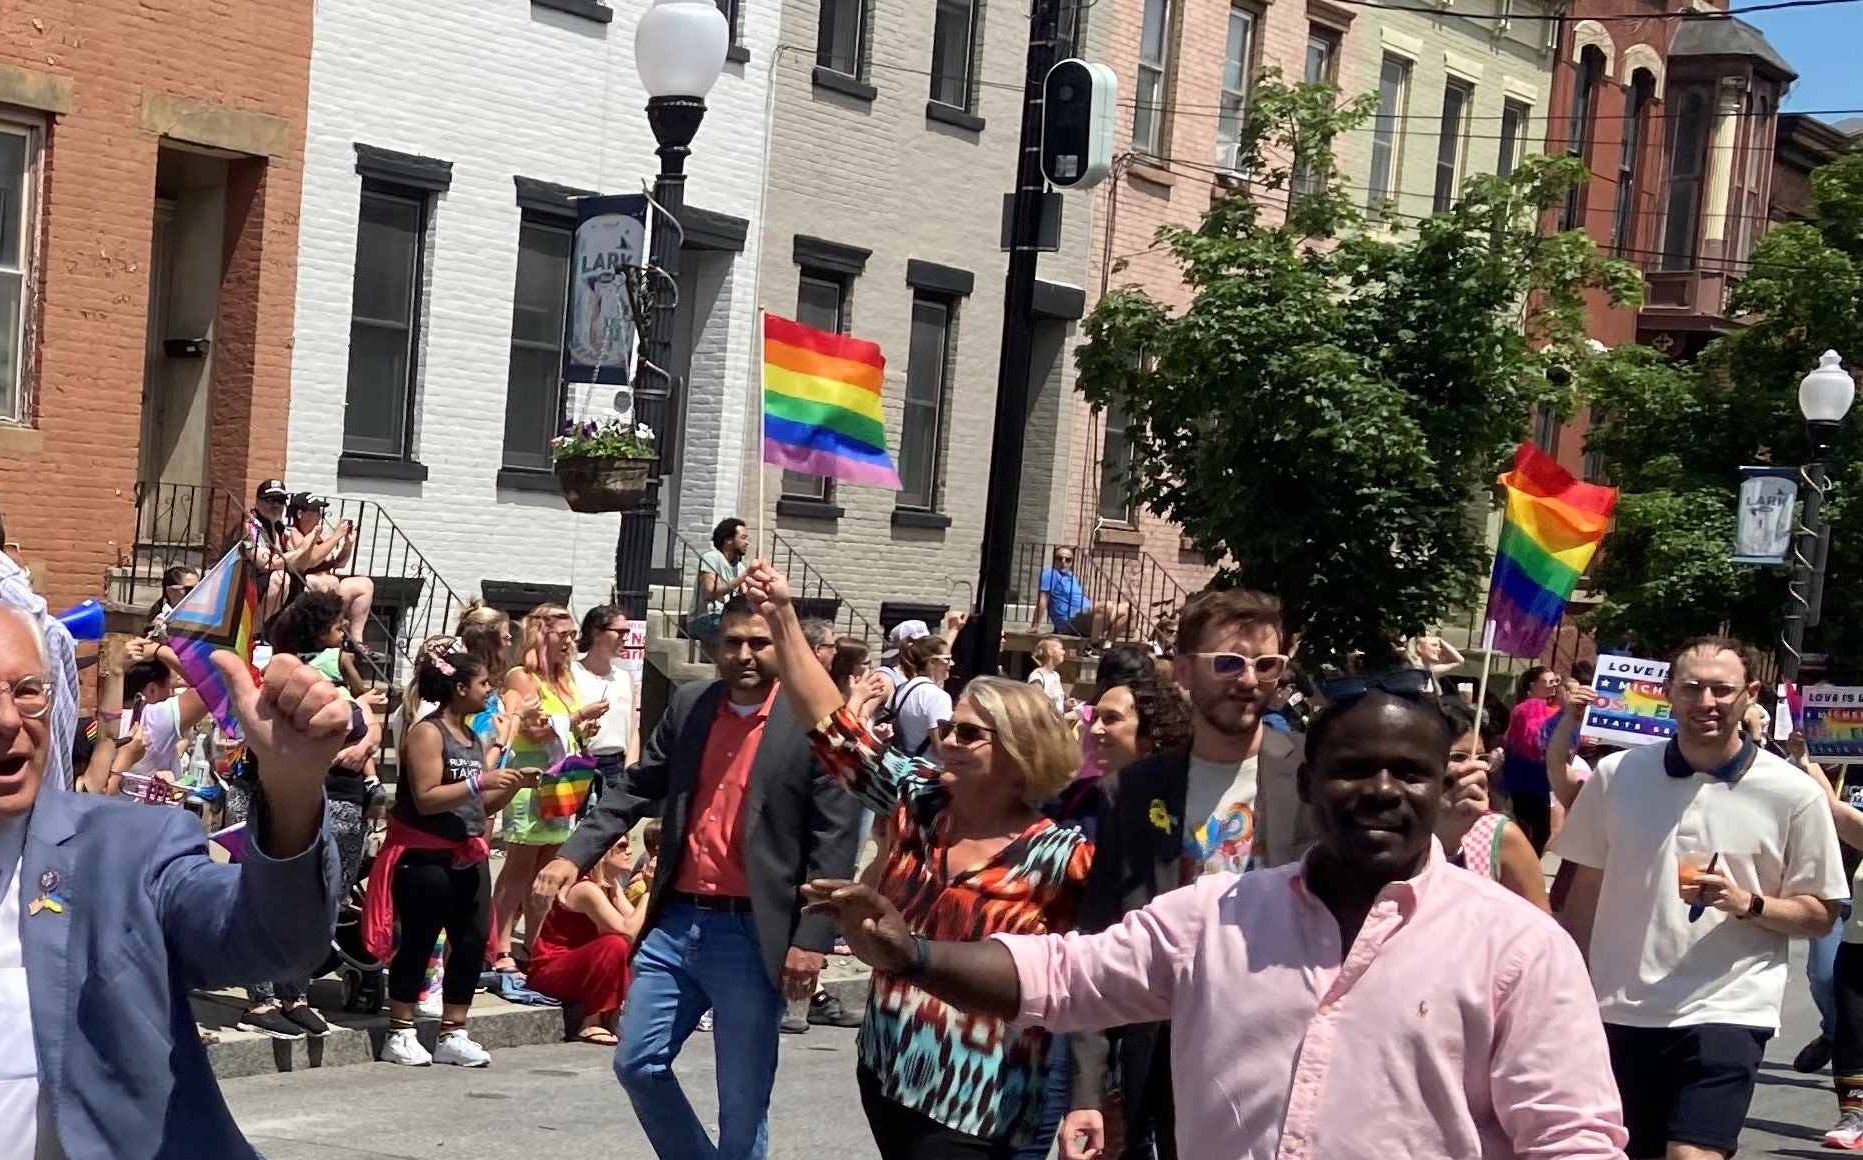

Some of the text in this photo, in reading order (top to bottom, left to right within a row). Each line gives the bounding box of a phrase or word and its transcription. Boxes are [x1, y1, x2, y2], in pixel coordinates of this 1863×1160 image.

[581, 252, 633, 273] LARK
[1608, 662, 1654, 677] LOVE
[1618, 681, 1666, 697] MICH
